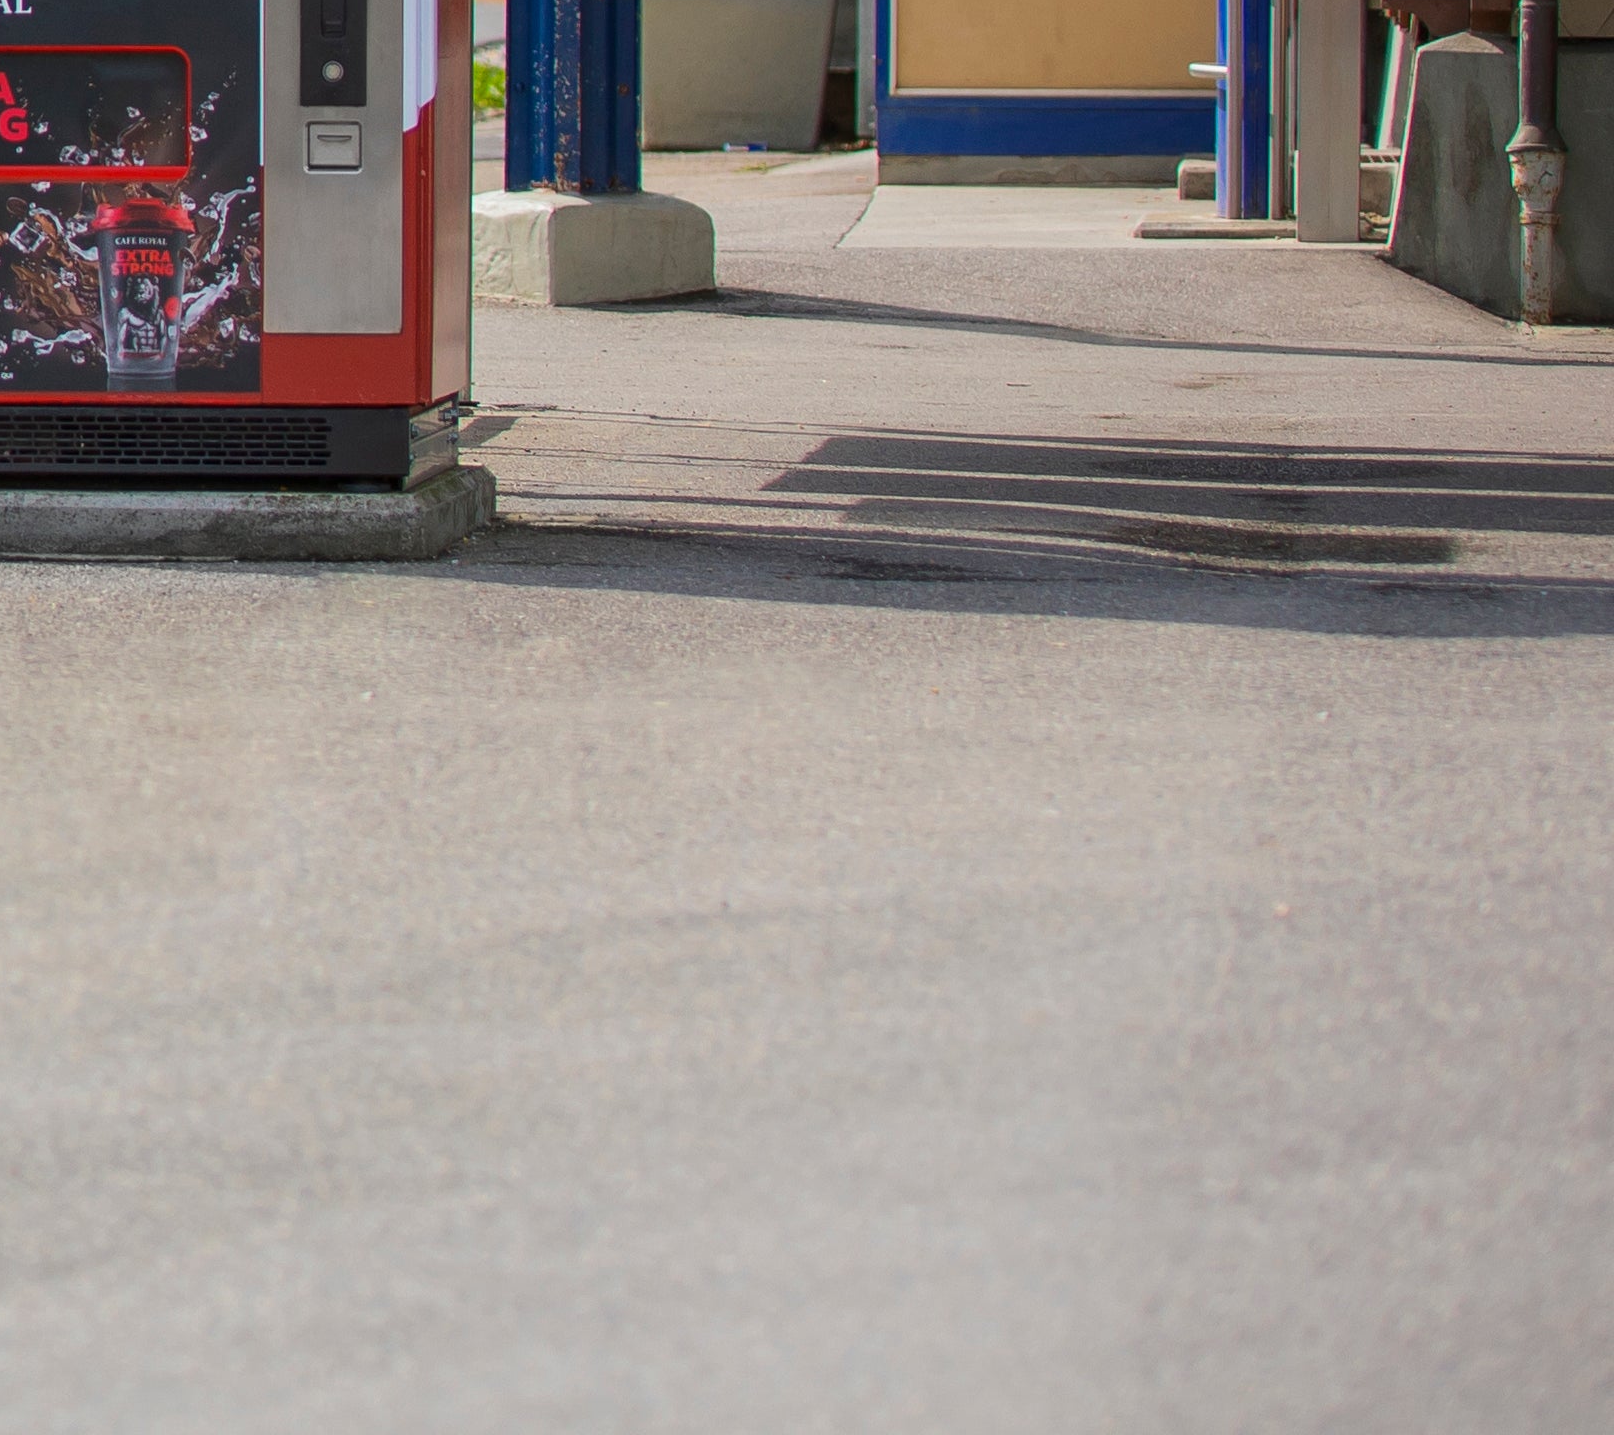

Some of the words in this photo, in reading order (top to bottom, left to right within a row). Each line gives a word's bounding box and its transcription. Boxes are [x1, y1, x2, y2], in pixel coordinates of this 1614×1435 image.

[138, 237, 168, 246] ROYAL
[114, 249, 171, 263] EXTRA
[110, 262, 175, 277] STRONG
